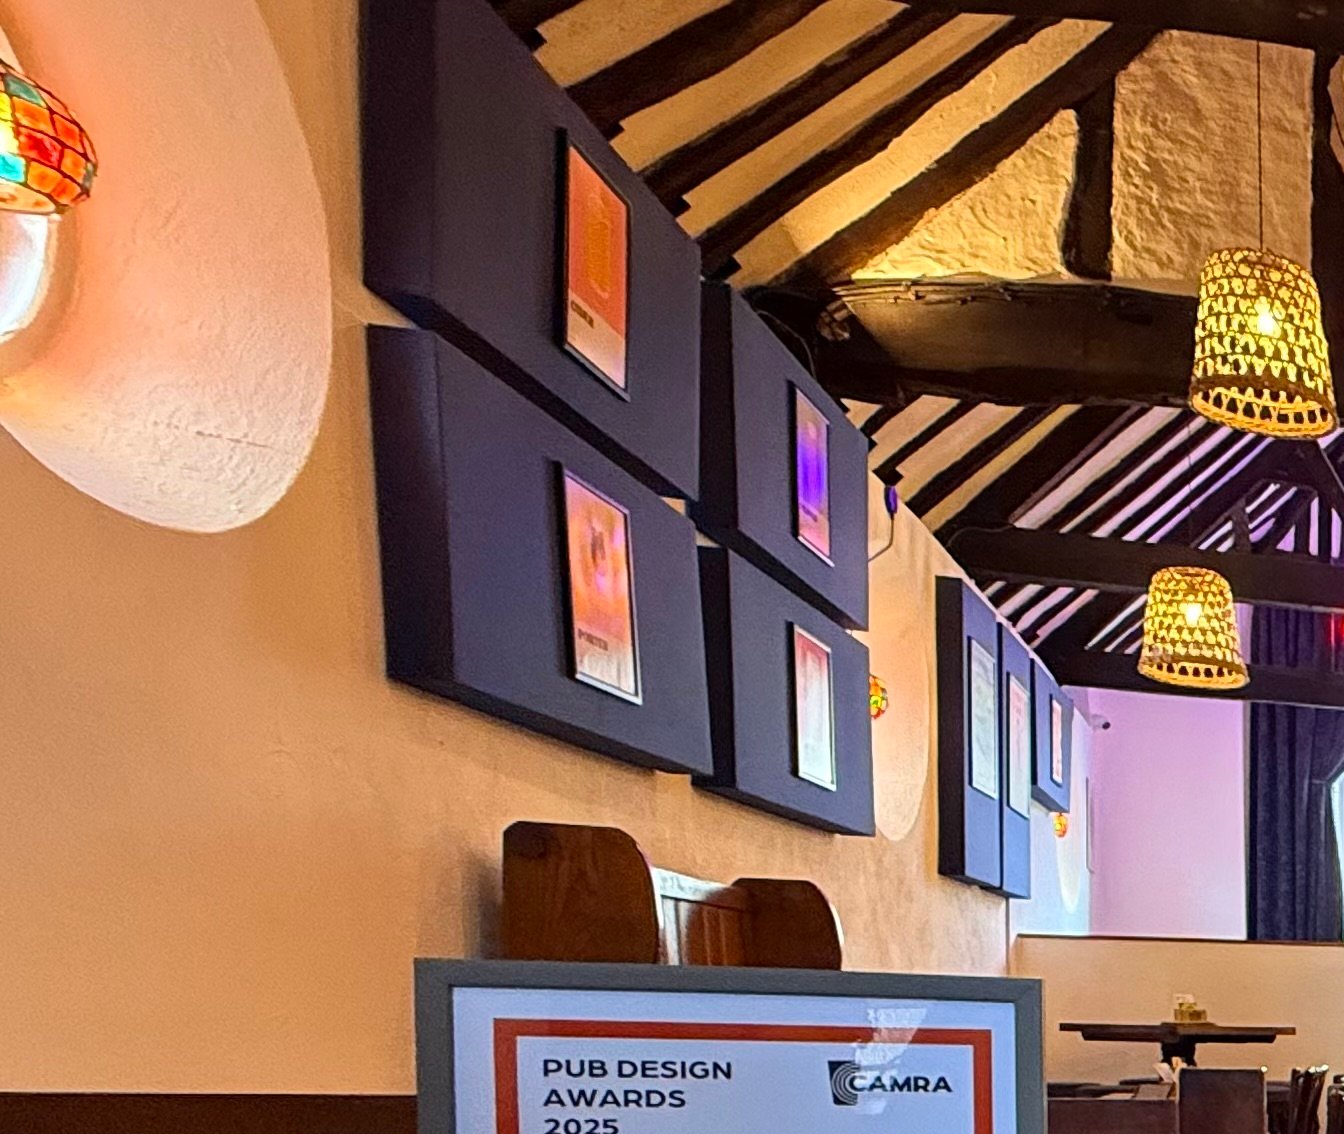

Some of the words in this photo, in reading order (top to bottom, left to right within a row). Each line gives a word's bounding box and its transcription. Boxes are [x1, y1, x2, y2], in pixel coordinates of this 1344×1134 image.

[543, 1059, 608, 1078] PUB
[617, 1060, 732, 1080] DESIGN
[848, 1074, 953, 1093] CAMRA
[543, 1088, 686, 1108] AWARDS
